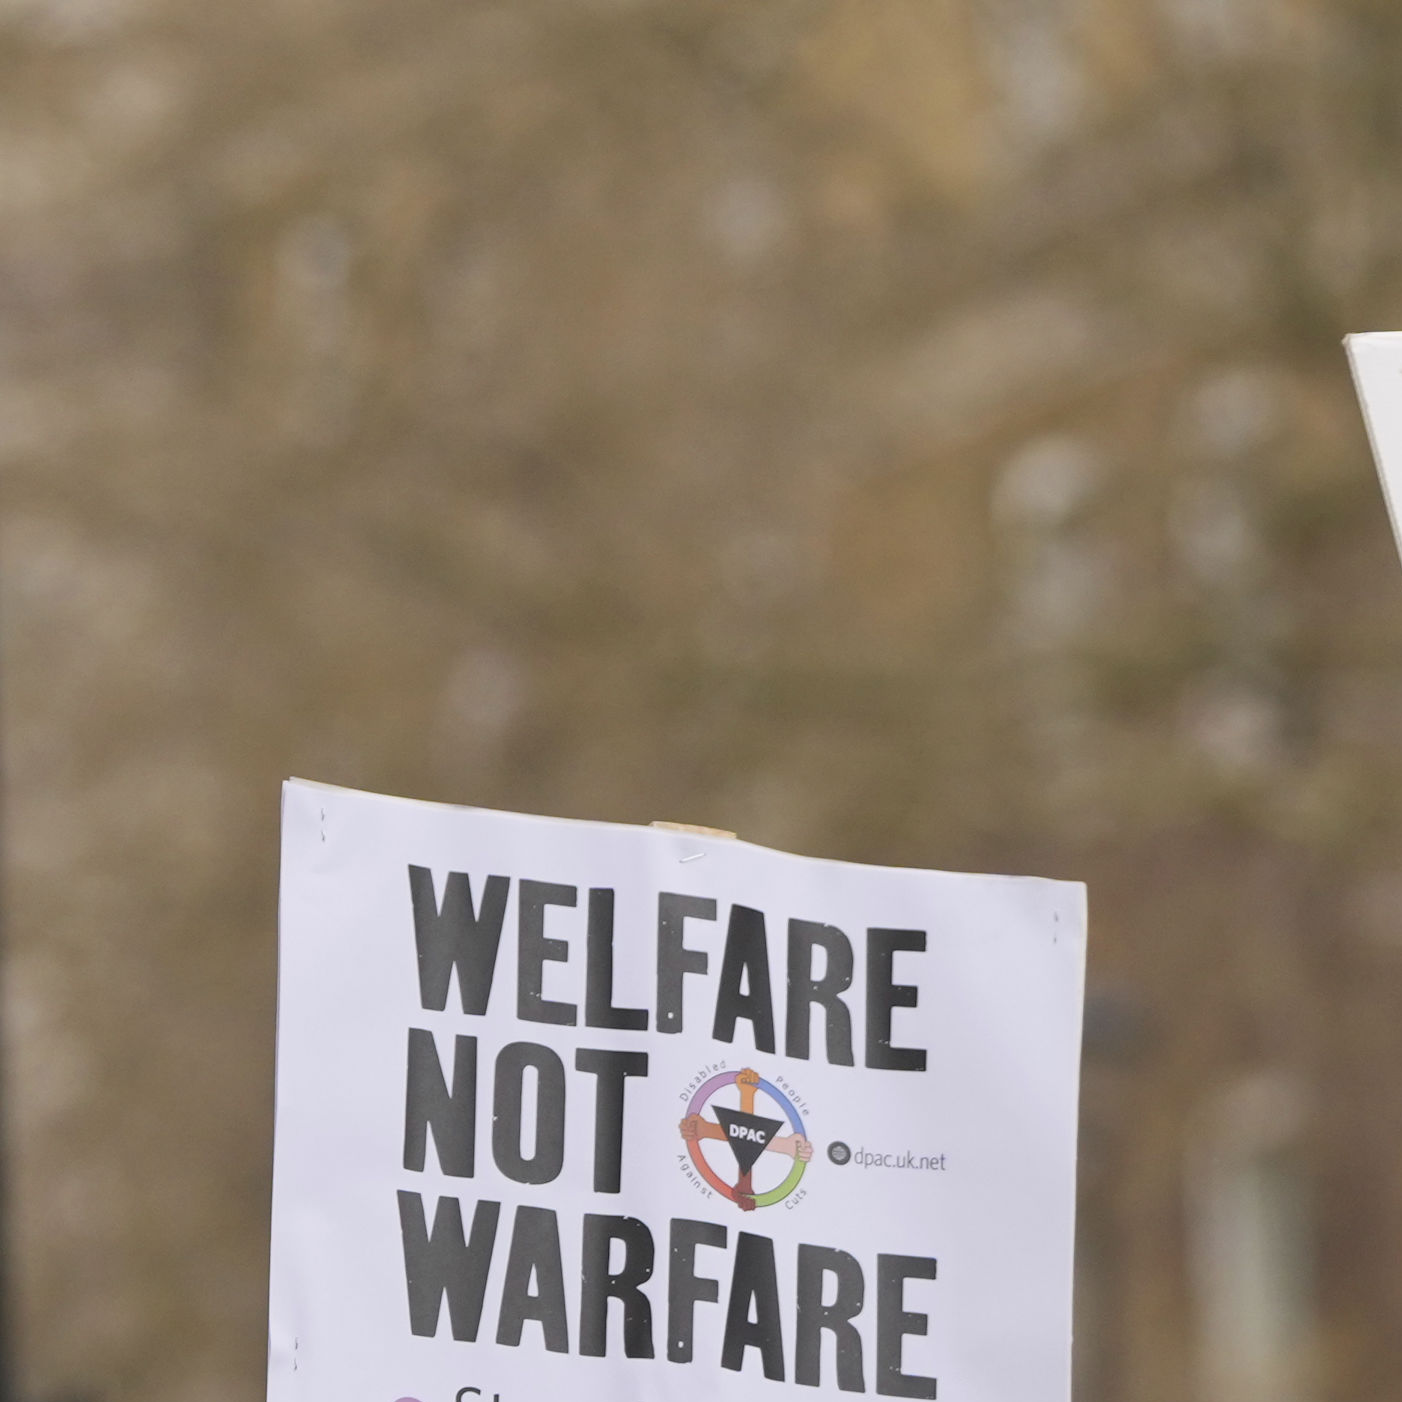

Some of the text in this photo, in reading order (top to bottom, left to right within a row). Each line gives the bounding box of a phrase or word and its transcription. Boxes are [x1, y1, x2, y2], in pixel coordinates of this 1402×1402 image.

[407, 863, 927, 1072] WELFARE
[402, 1027, 649, 1194] NOT
[679, 1060, 810, 1117] Disabled People
[729, 1124, 766, 1144] DPAC
[854, 1147, 946, 1171] dpac.uk.net
[677, 1154, 808, 1211] Against Cuts
[396, 1189, 938, 1400] WARFARE
